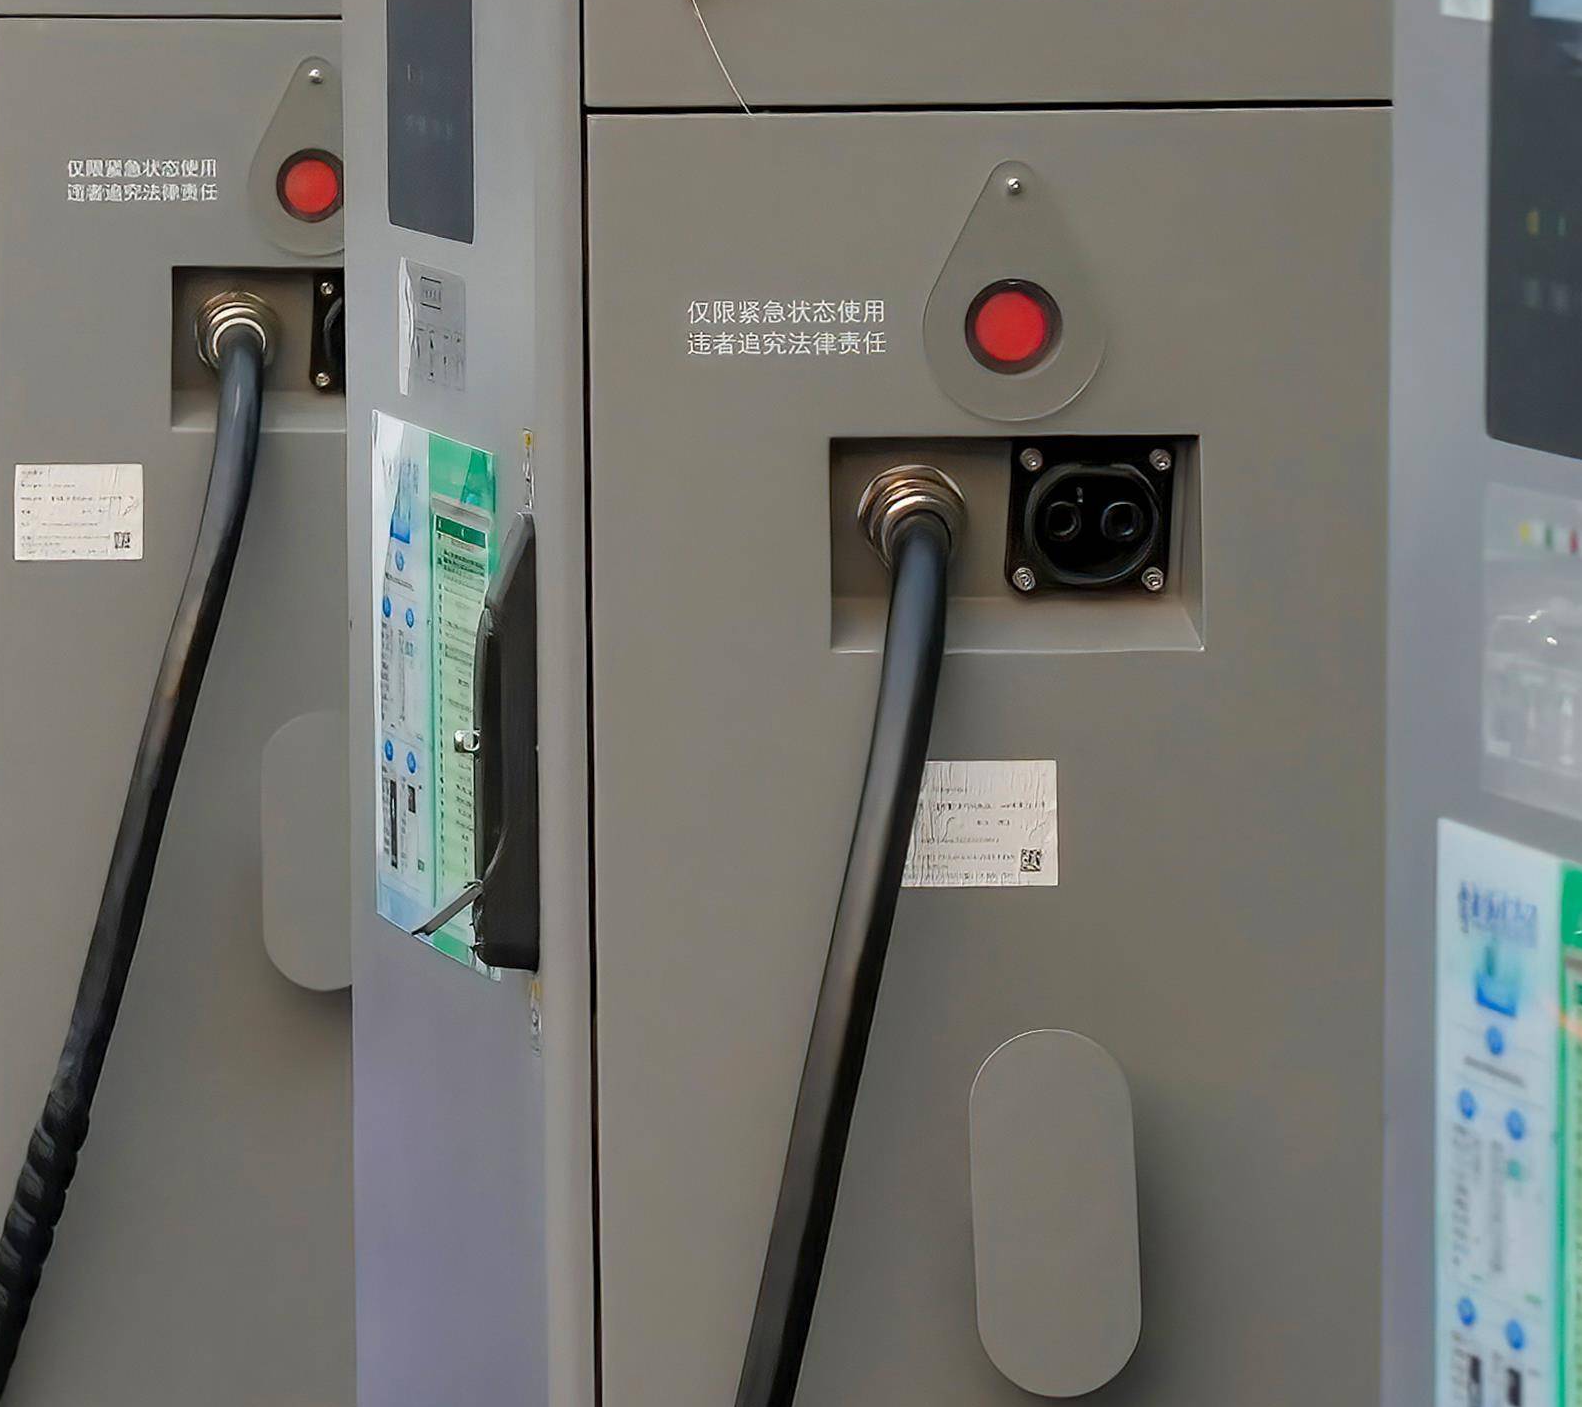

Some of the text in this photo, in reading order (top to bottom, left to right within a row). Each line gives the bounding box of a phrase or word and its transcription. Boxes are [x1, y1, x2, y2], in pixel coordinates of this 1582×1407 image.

[687, 299, 886, 325] 仅限紧急状态使用
[687, 330, 888, 356] 违者追究法律责任
